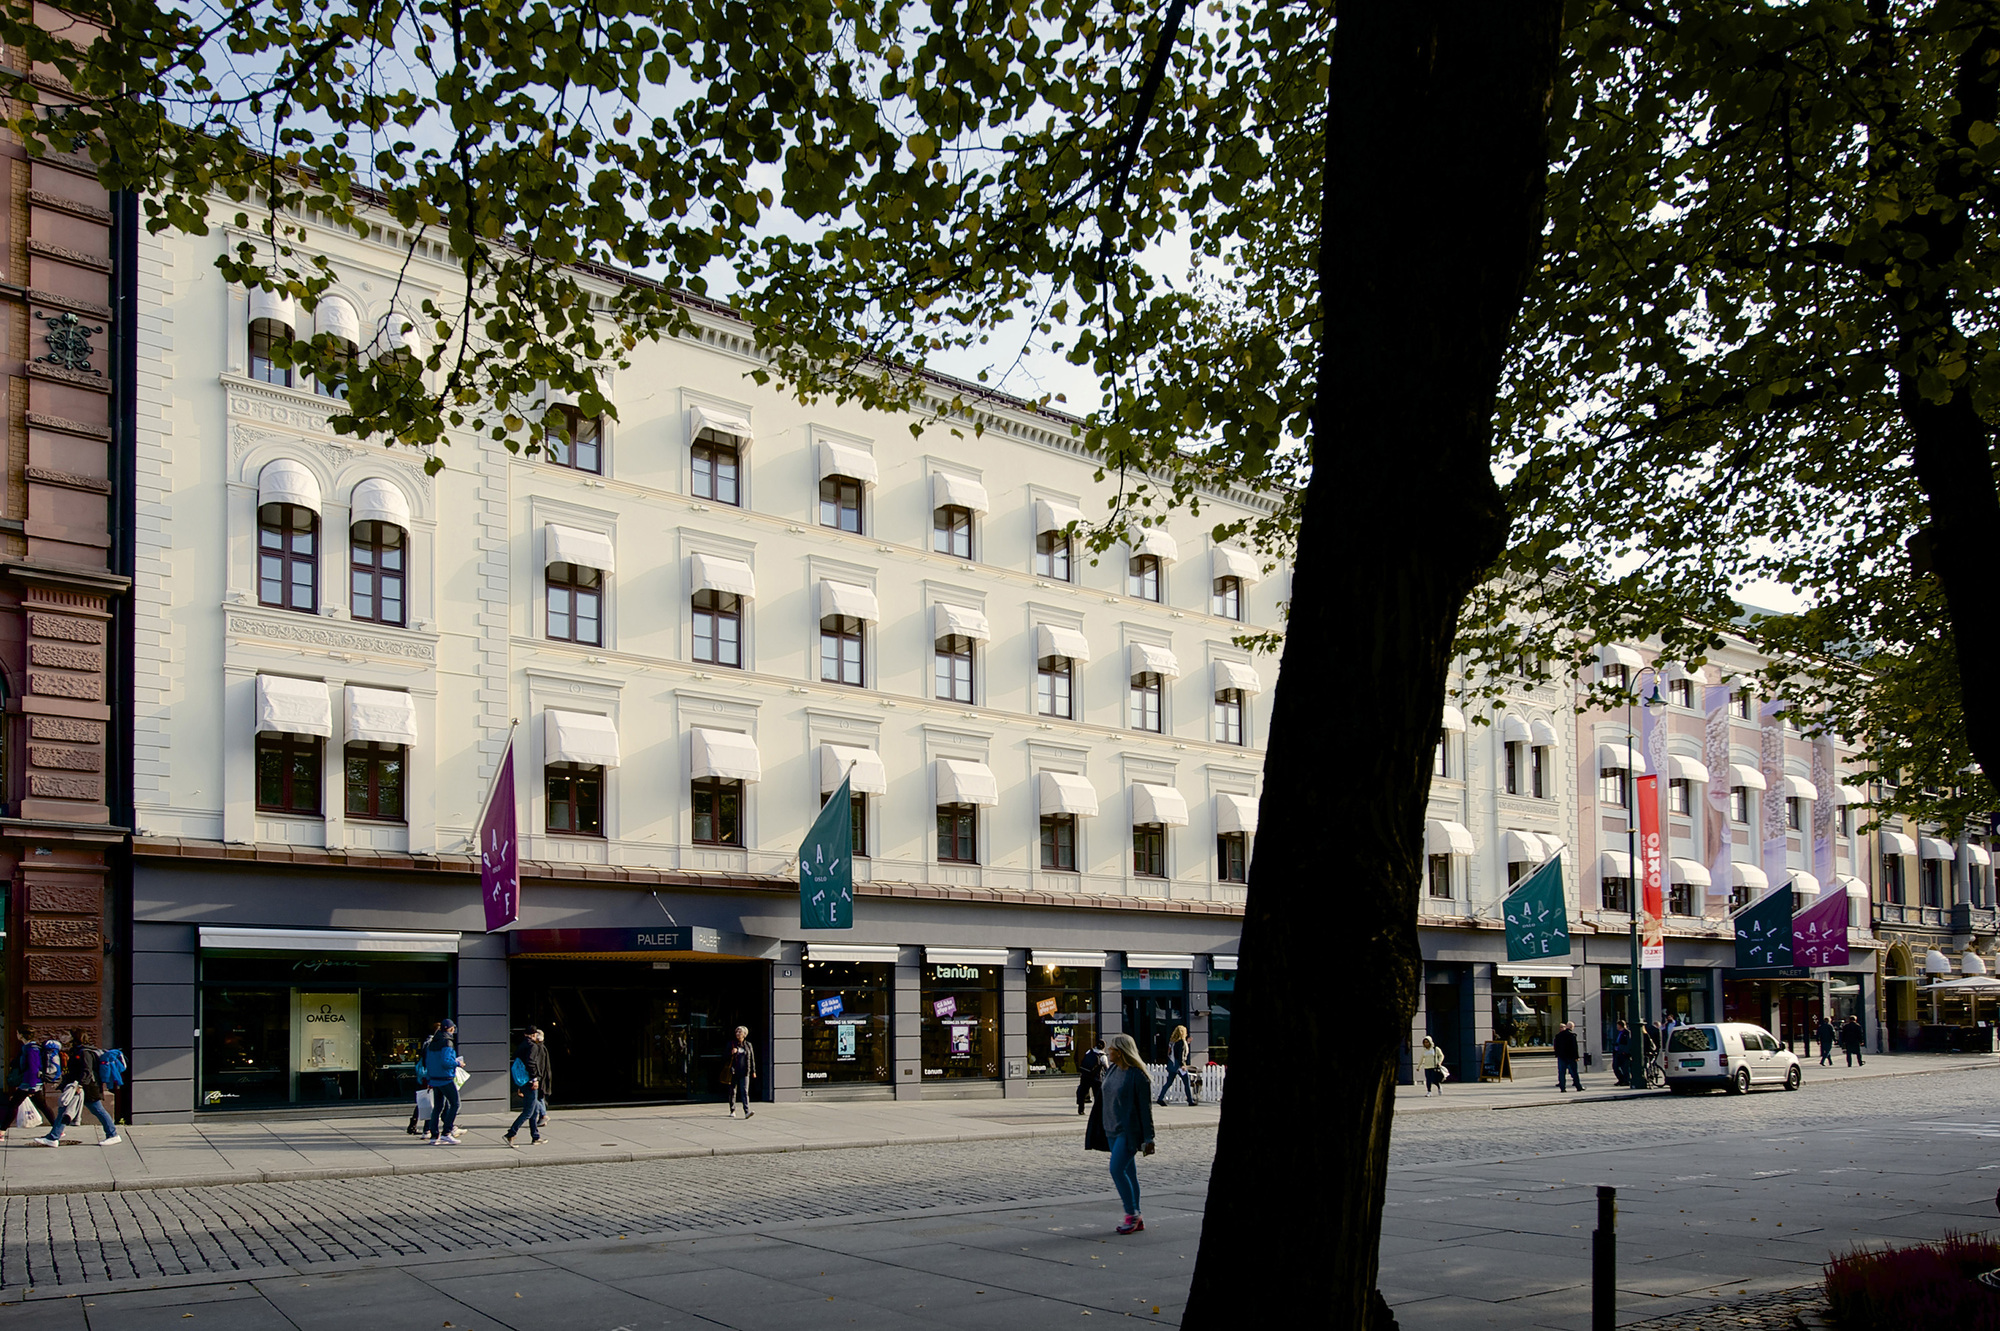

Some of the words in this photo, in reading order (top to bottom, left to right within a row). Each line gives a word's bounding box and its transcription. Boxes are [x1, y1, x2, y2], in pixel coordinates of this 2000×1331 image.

[637, 933, 679, 945] PALEET
[936, 965, 979, 979] tanum
[1610, 974, 1629, 984] YME
[306, 1014, 346, 1023] OMEGA
[806, 1071, 828, 1079] tanum
